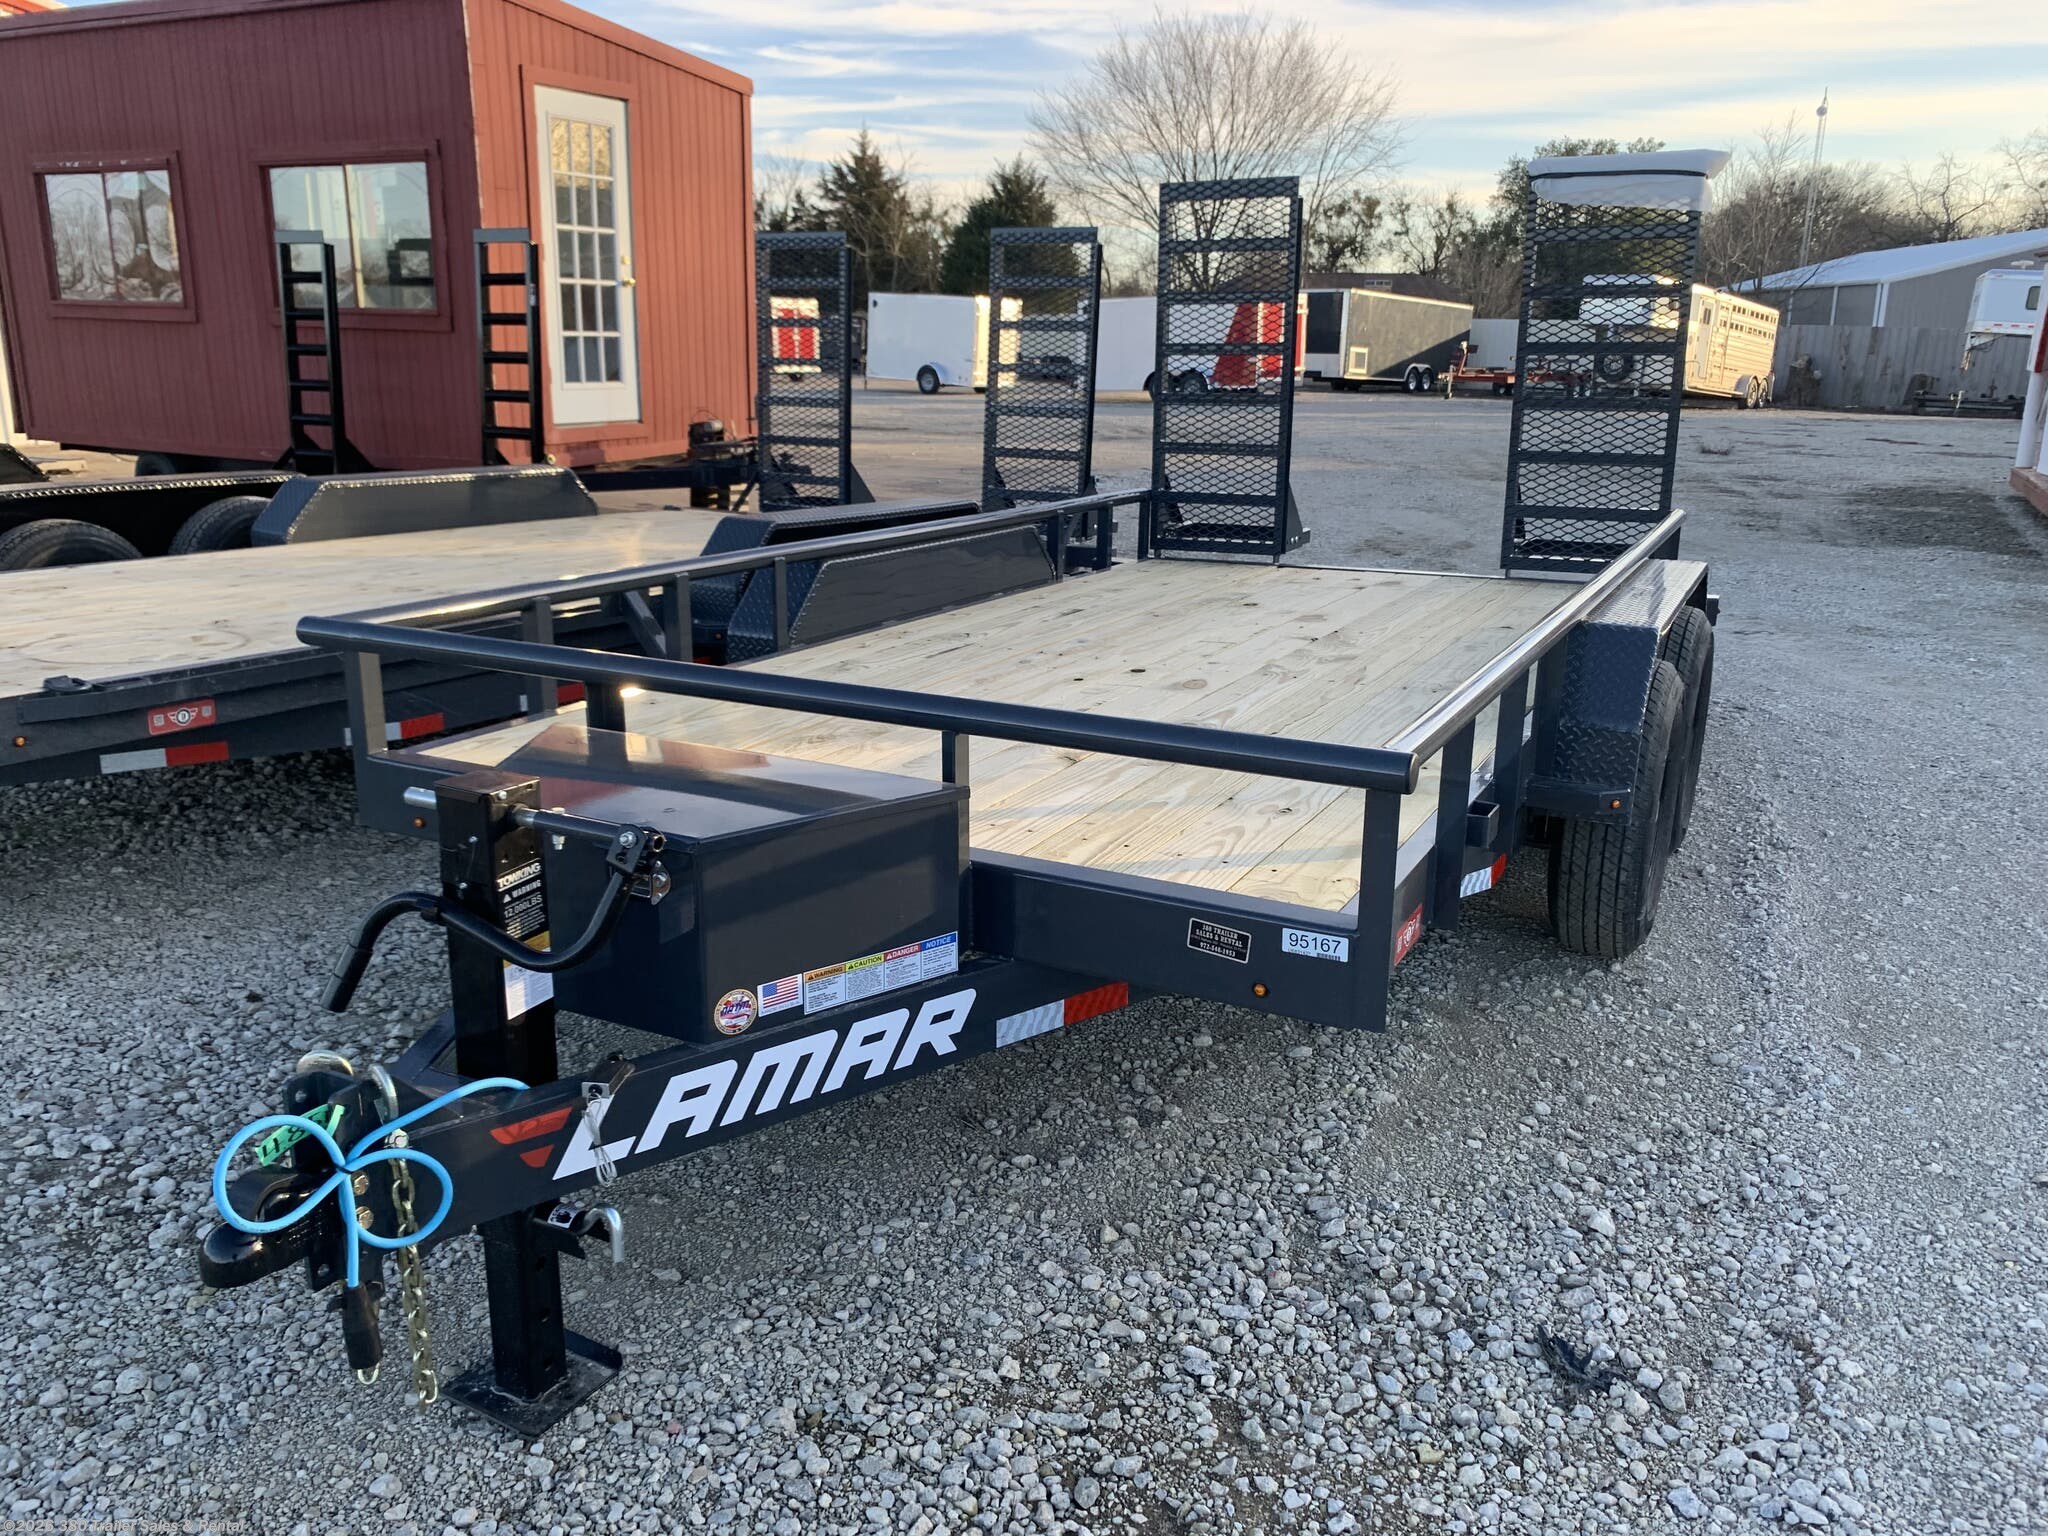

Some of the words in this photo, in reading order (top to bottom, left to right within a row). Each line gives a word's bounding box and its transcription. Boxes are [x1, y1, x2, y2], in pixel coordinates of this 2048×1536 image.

[496, 862, 542, 888] TOWKING
[511, 879, 542, 898] WARNING
[1195, 929, 1213, 939] SALES
[1220, 935, 1243, 947] RENTAL
[1213, 927, 1239, 939] TRAILER
[925, 936, 952, 949] NOTICE
[1289, 932, 1341, 954] 95167
[892, 945, 919, 958] DANGER
[853, 955, 883, 968] CAUTION
[813, 966, 843, 979] WARNING
[552, 988, 977, 1181] LAMAR
